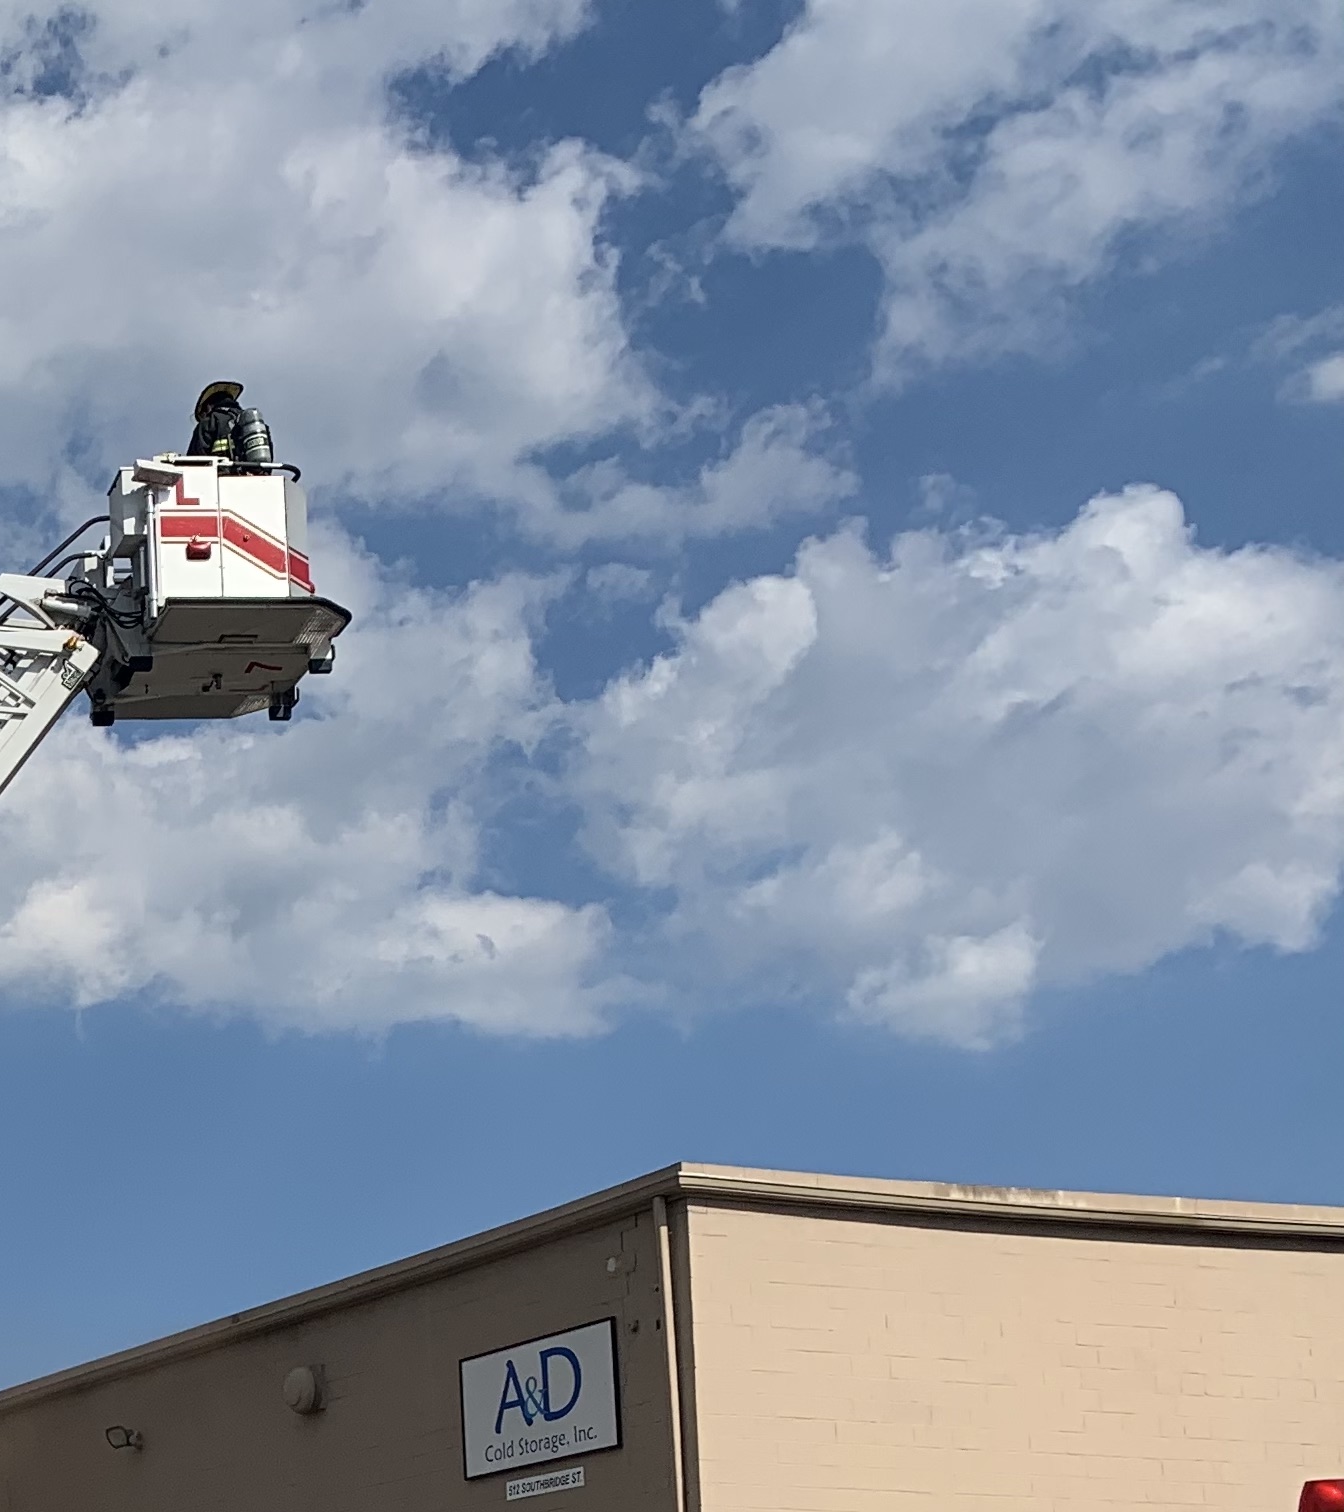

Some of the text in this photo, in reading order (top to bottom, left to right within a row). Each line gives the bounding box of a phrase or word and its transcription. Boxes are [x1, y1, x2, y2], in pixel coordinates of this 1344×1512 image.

[495, 1346, 582, 1435] A&D
[485, 1440, 514, 1462] Cold
[574, 1425, 598, 1443] Inc.
[508, 1483, 520, 1496] 512
[521, 1473, 570, 1493] SOUTHBRIDGE
